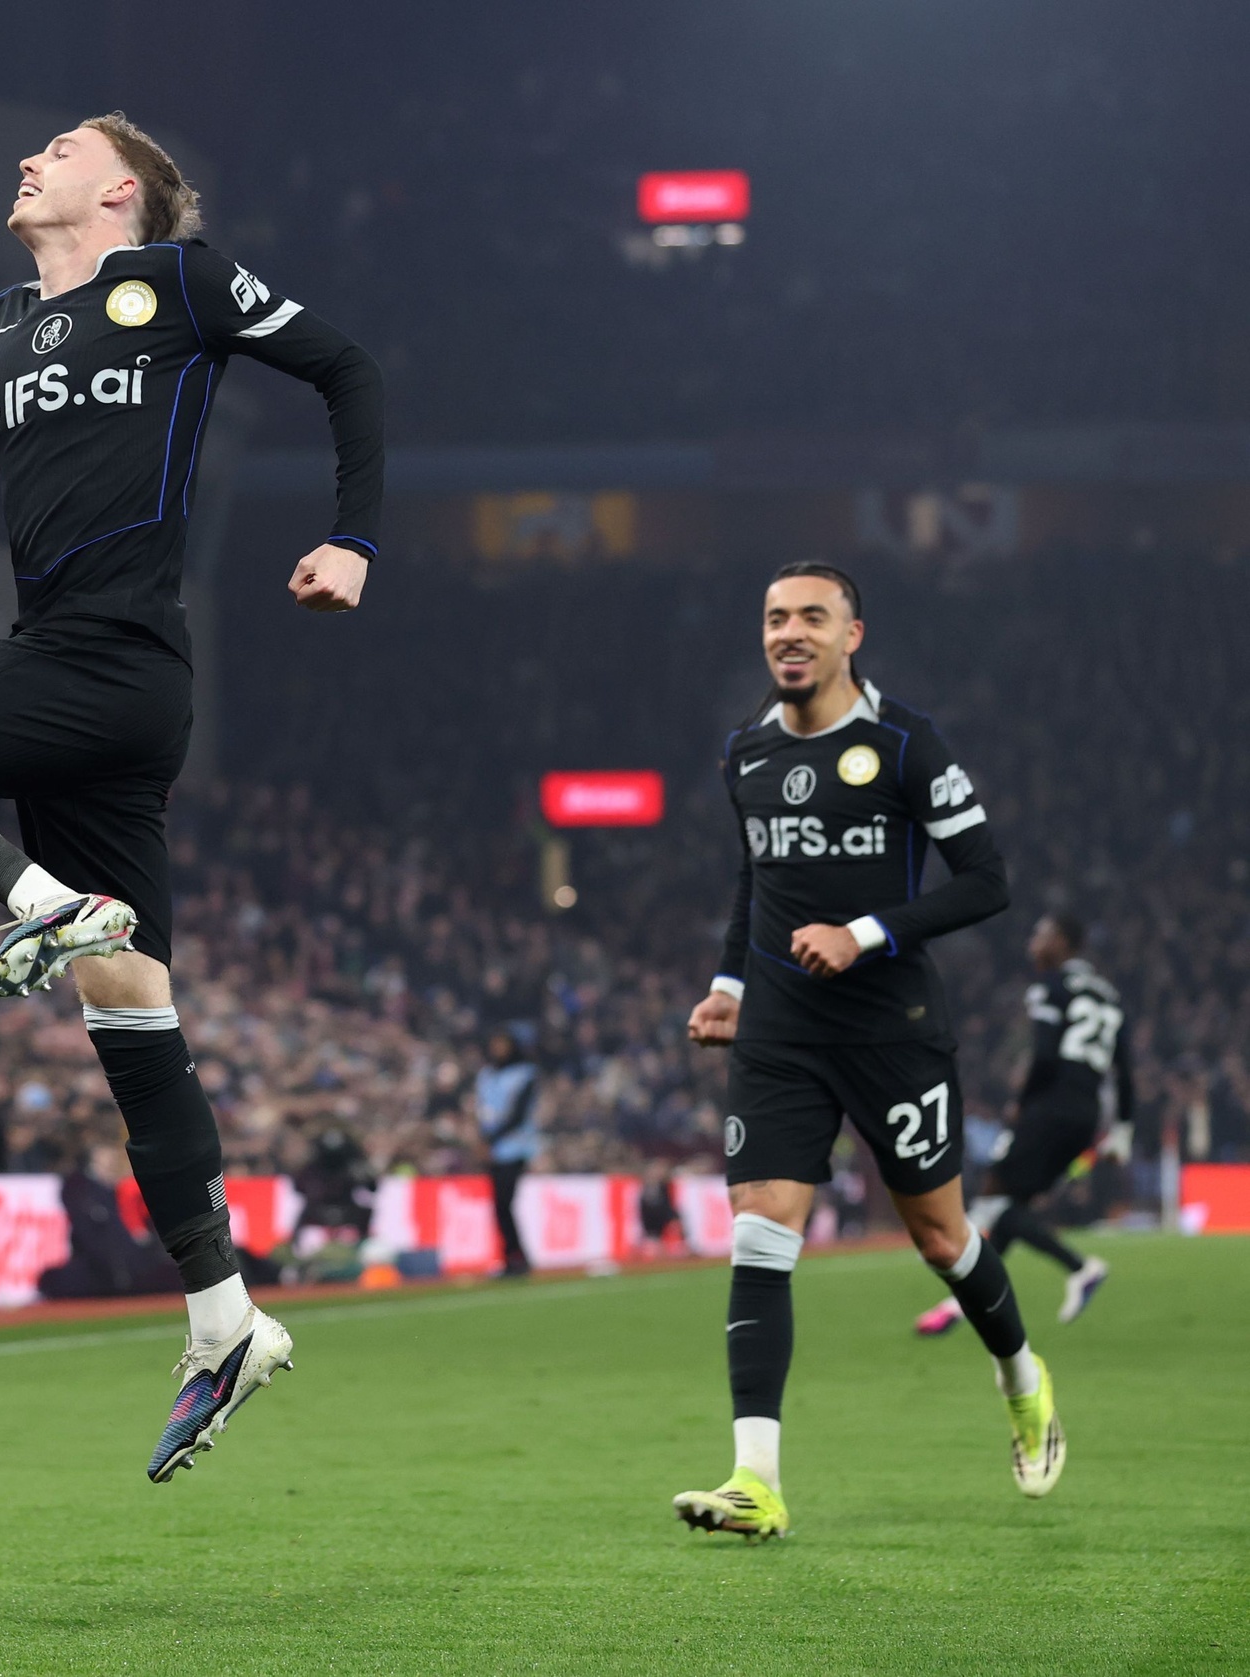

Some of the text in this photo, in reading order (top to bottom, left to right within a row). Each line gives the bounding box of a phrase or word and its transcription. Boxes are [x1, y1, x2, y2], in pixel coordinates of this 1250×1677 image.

[119, 315, 138, 323] FIFA
[4, 355, 151, 430] IFS.ai
[769, 814, 888, 858] IFS.ai
[886, 1081, 950, 1159] 27
